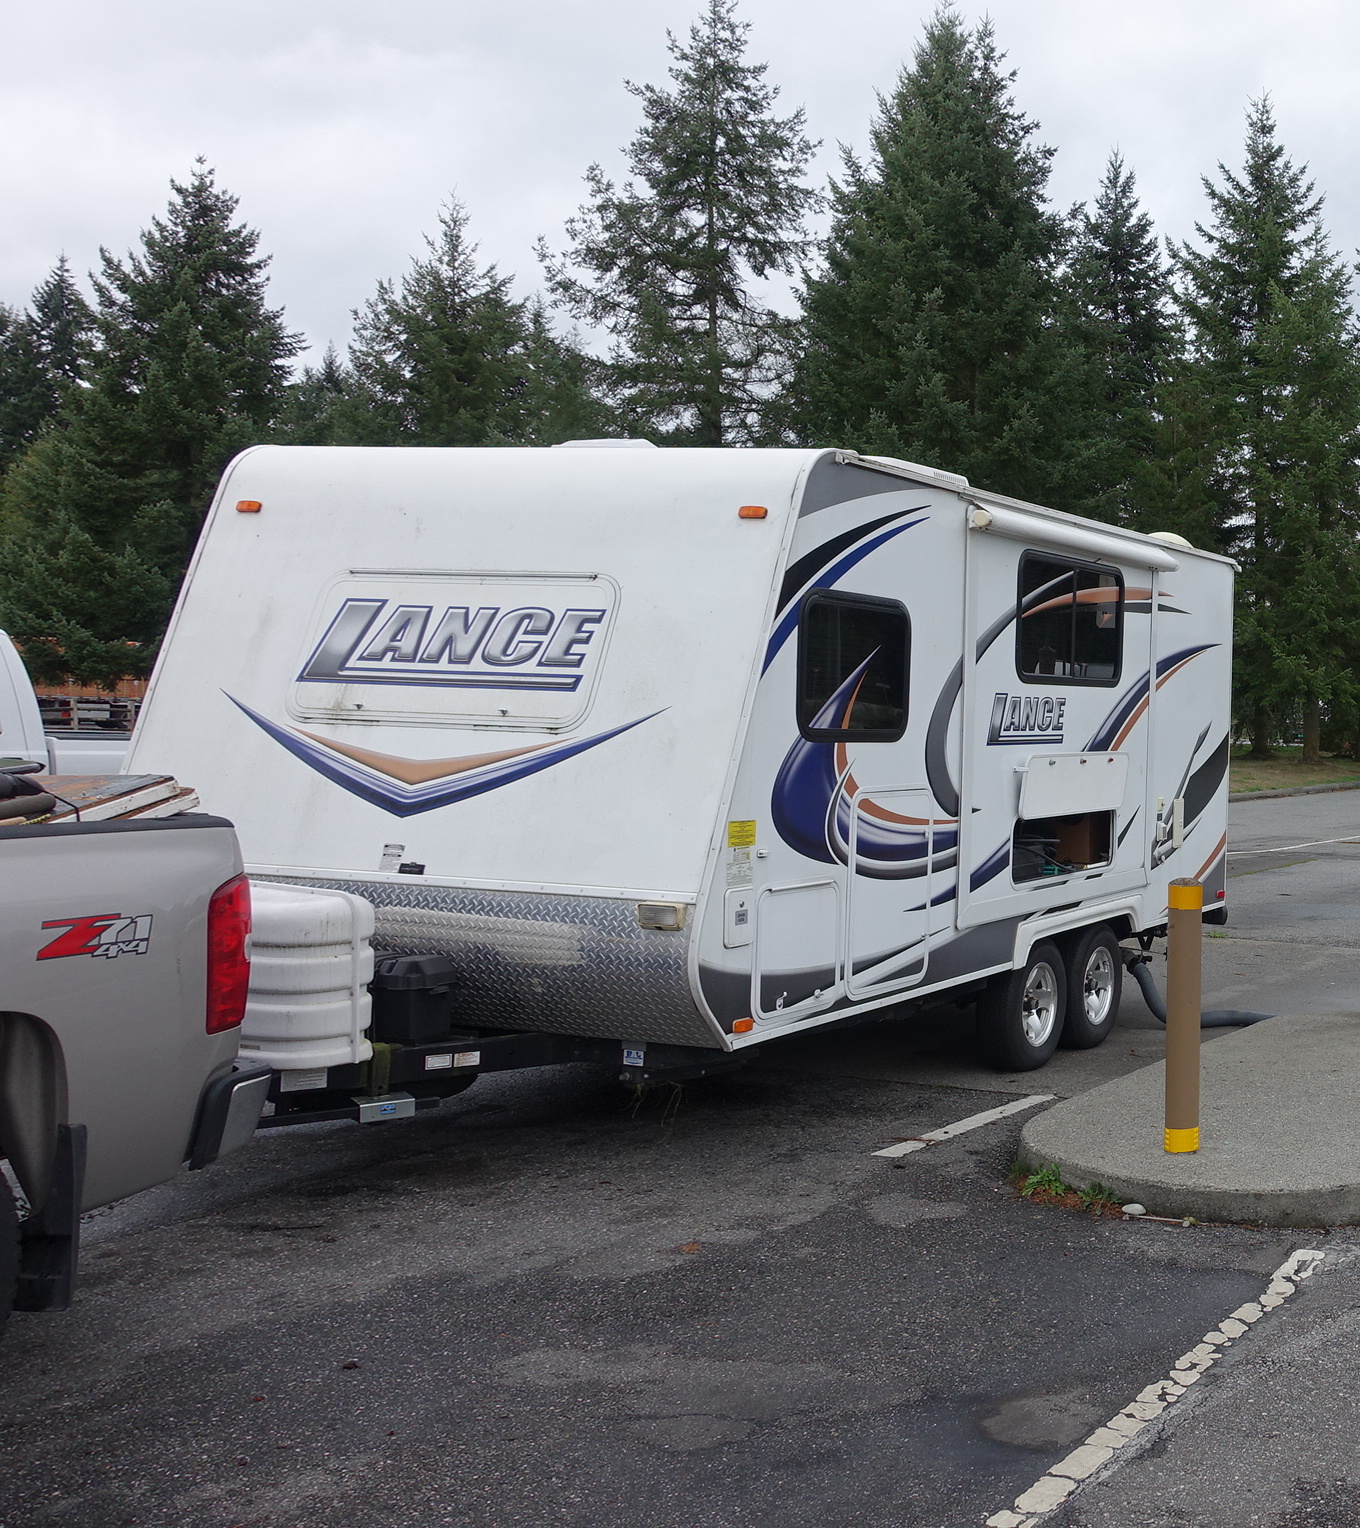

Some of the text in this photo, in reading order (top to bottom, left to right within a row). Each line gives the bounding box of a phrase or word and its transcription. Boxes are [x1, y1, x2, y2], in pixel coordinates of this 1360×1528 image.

[295, 597, 607, 692] LANCE
[986, 692, 1067, 746] LANCE
[36, 913, 153, 961] Z71
